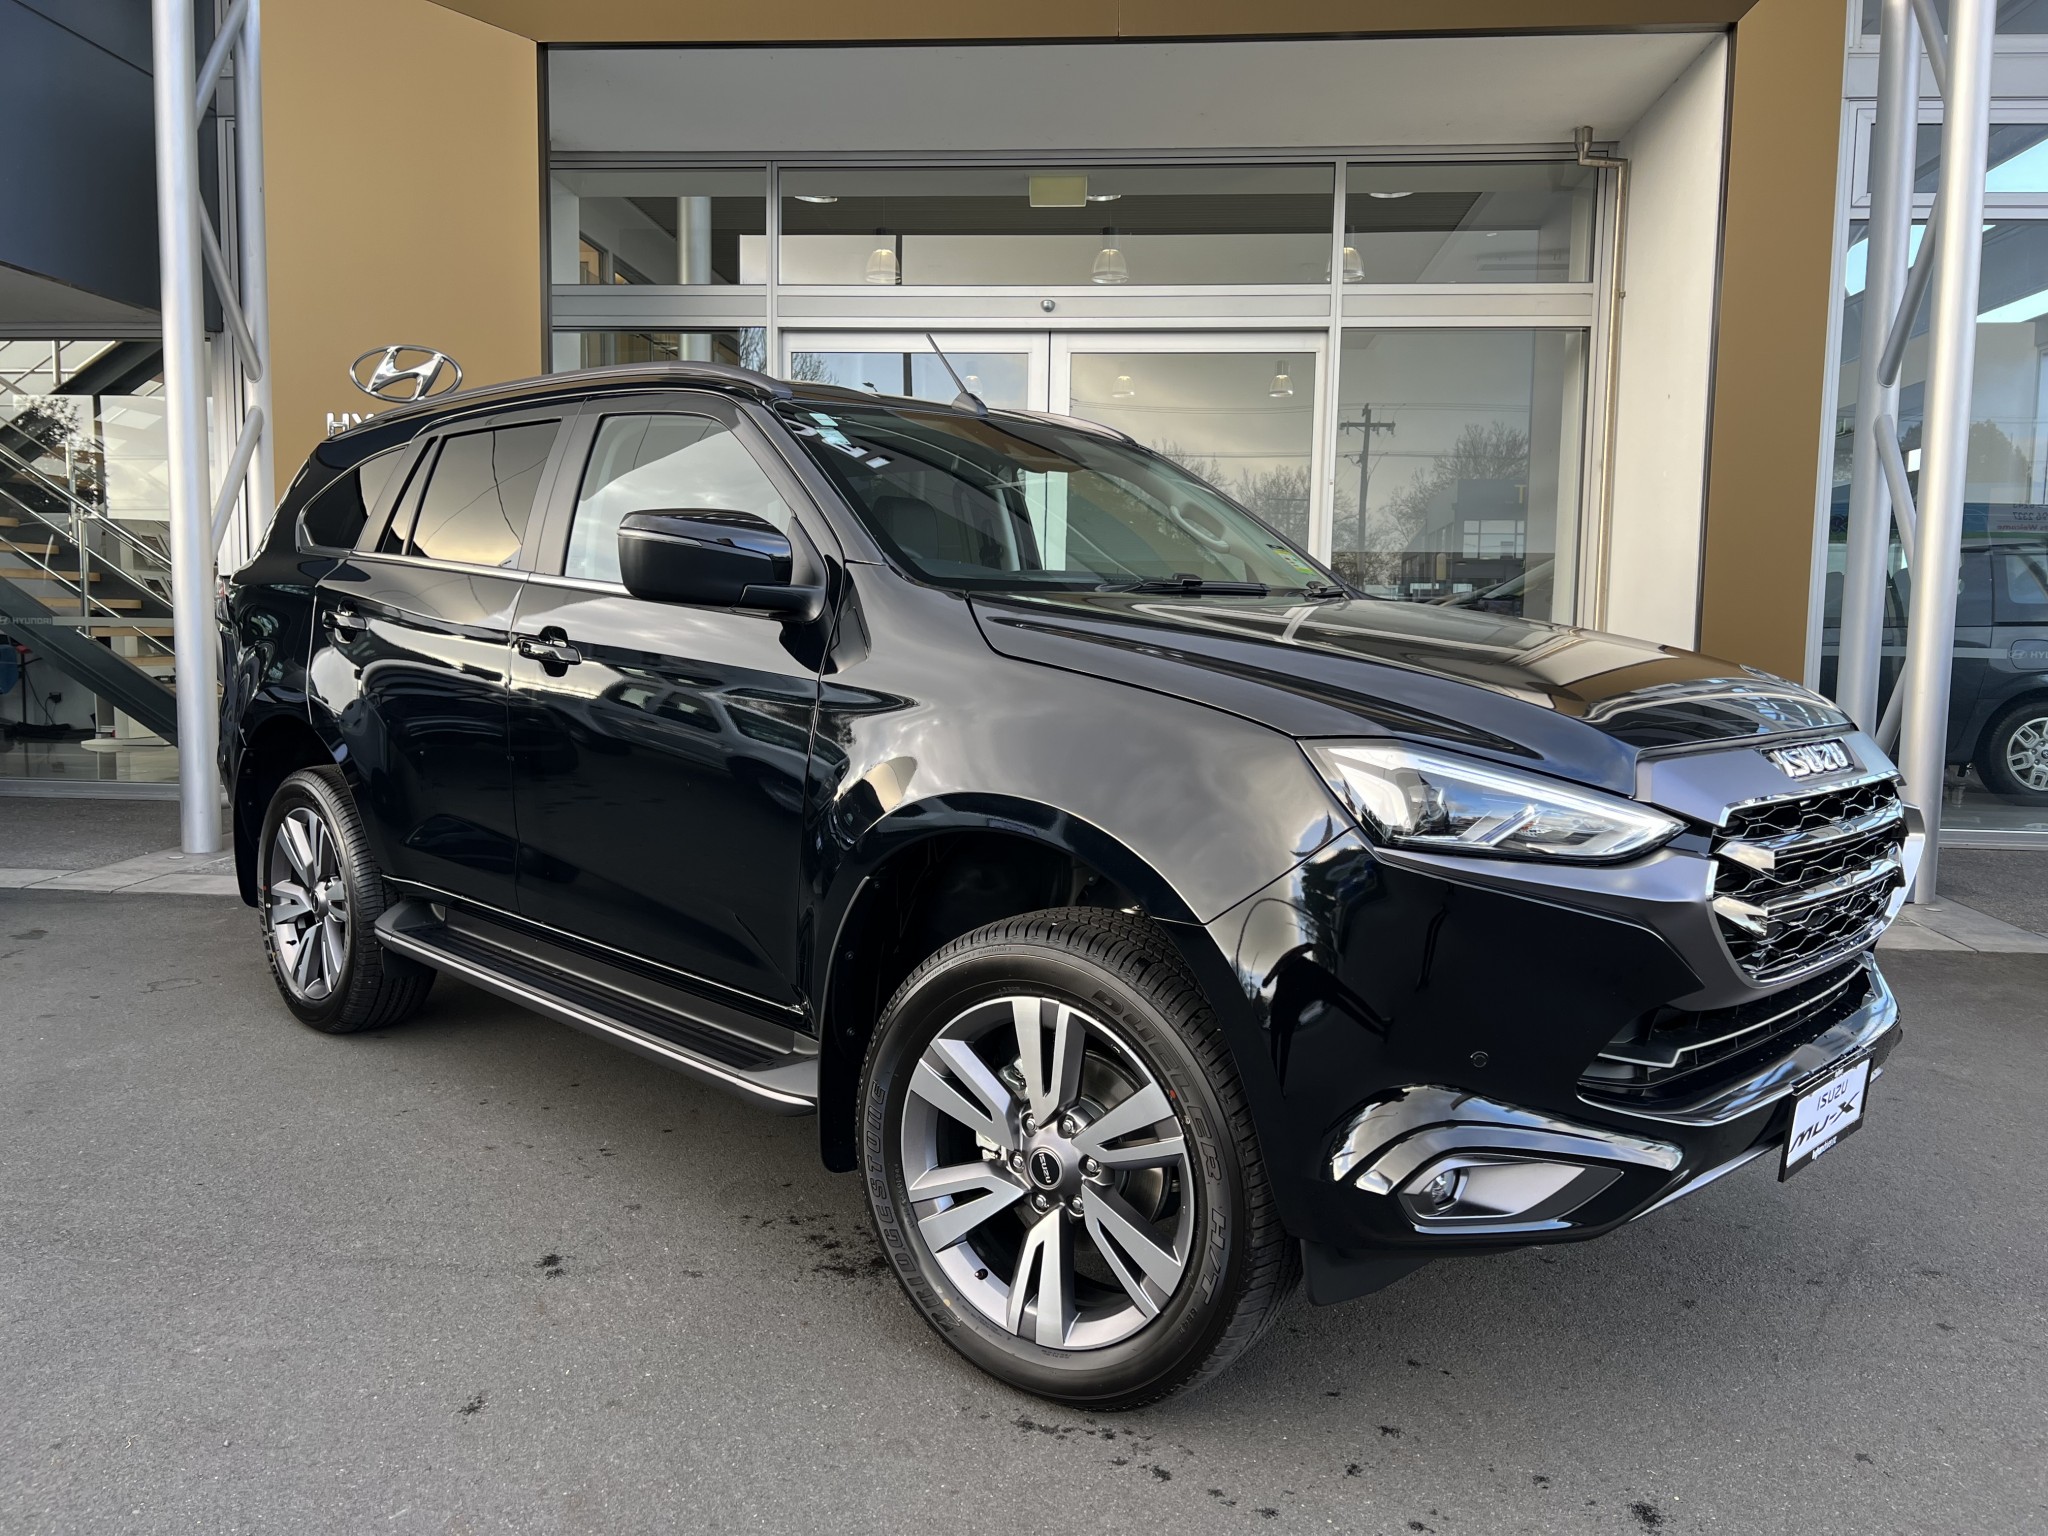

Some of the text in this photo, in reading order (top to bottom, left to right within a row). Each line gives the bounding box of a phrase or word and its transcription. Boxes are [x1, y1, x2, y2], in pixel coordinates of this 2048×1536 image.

[12, 617, 52, 625] HYUNDAI
[1769, 742, 1848, 777] ISUZU
[1092, 989, 1222, 1181] DUELER
[1817, 1079, 1849, 1111] ISUZU
[1038, 1153, 1052, 1184] ISUZU
[866, 1079, 961, 1333] BRIDGESTONE
